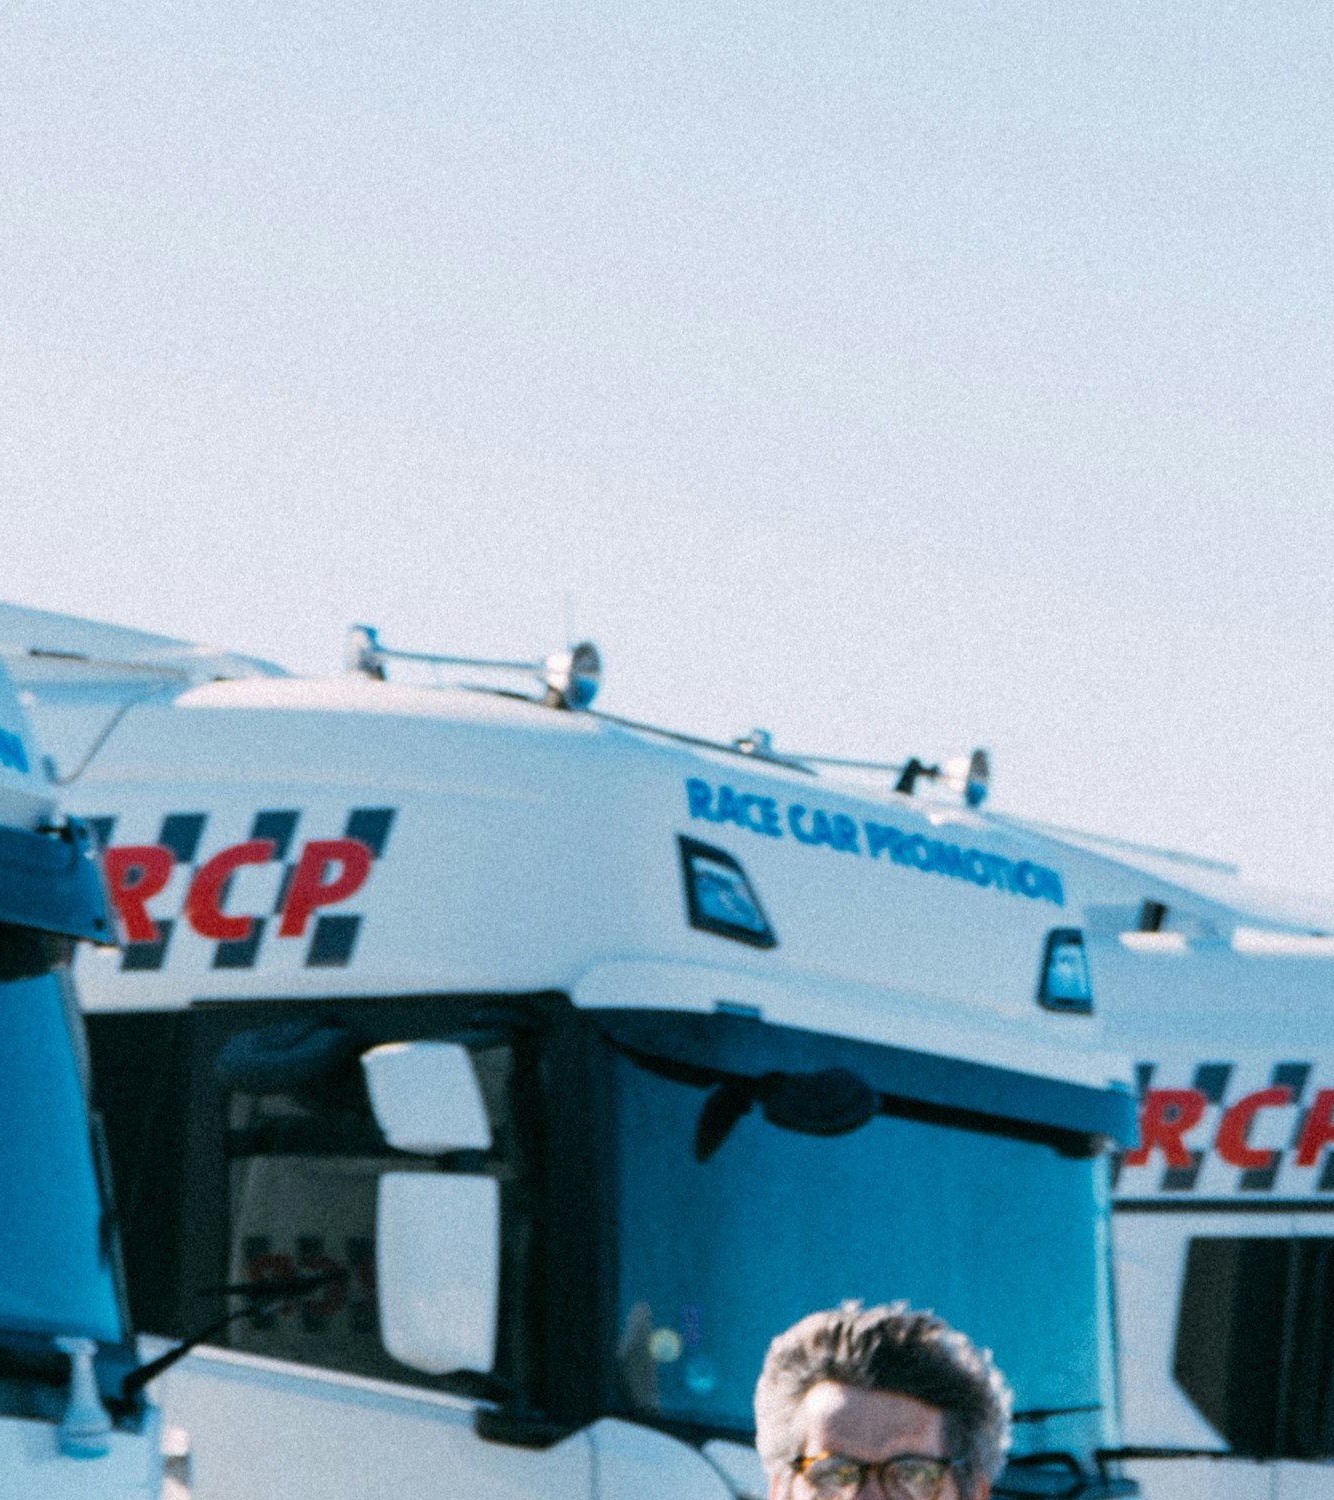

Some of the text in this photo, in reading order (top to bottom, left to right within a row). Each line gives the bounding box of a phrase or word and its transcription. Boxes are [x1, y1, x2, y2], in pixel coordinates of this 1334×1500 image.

[101, 838, 375, 943] RCP
[686, 777, 1066, 908] RACE CAR PROMOTION
